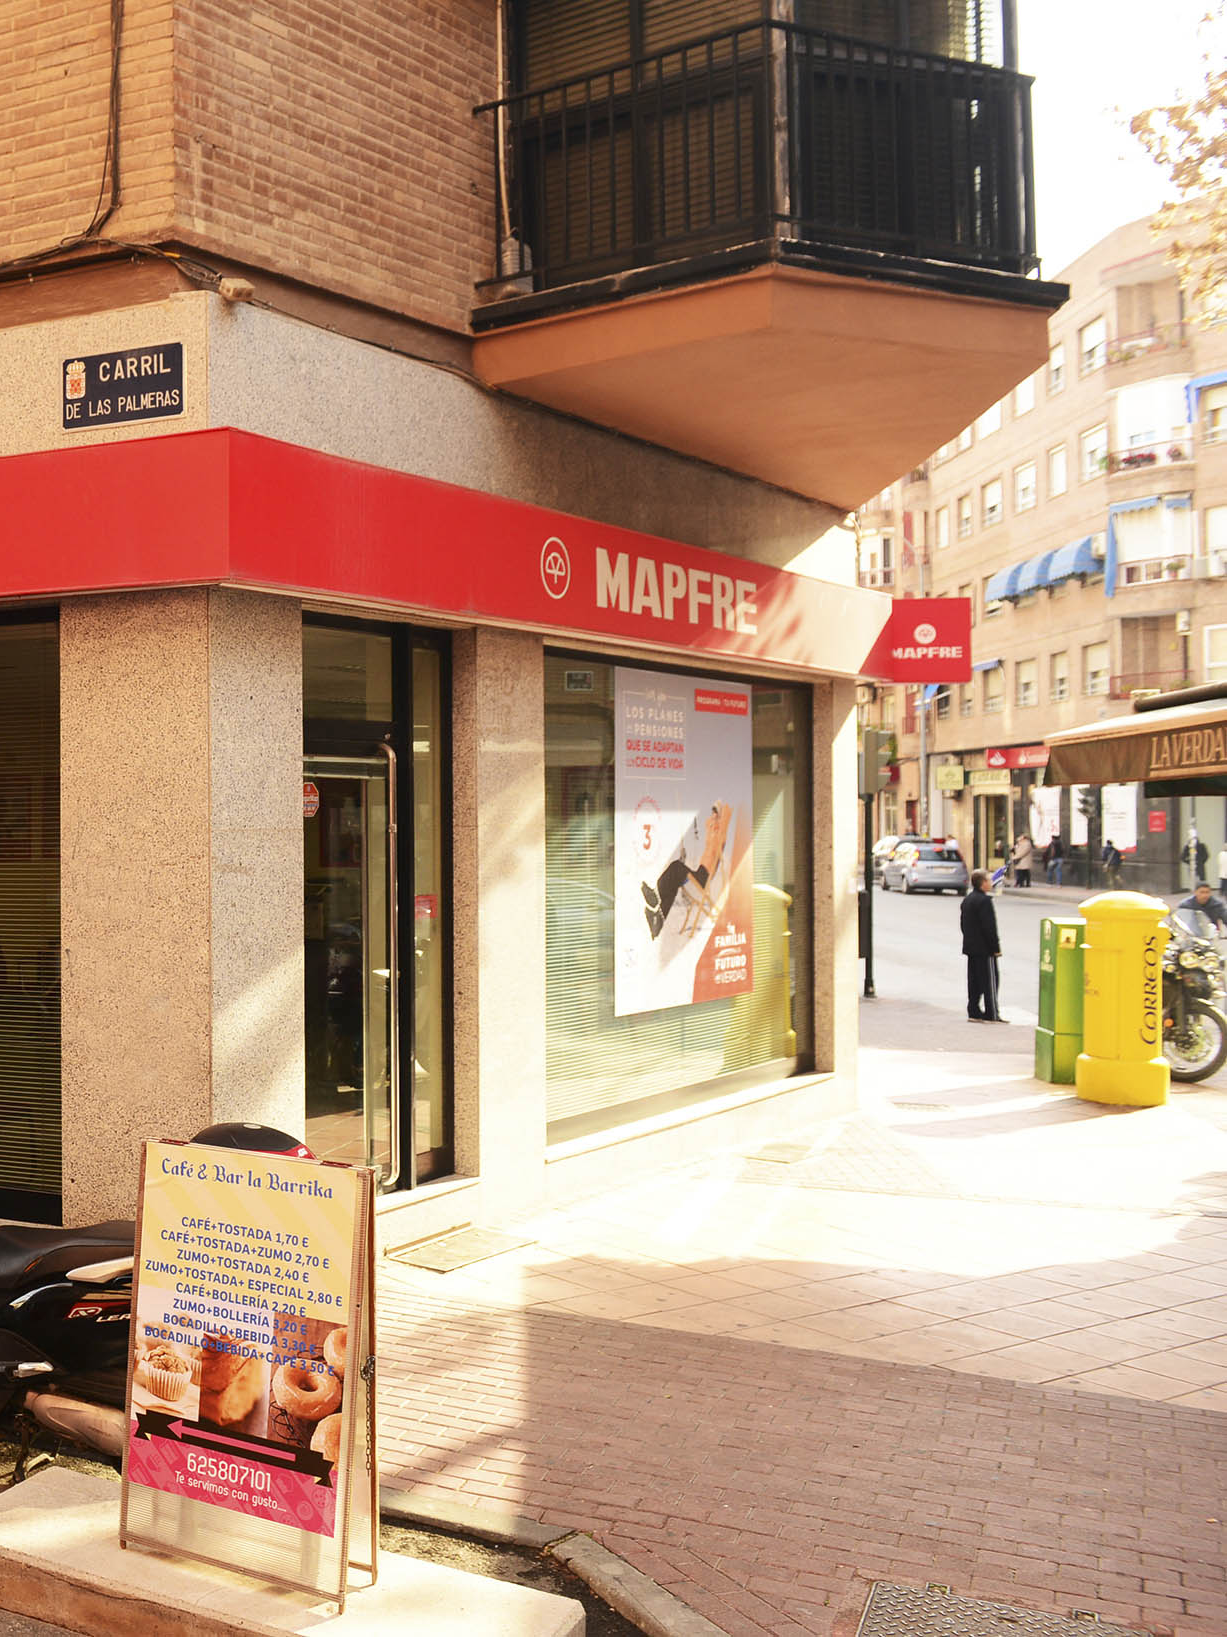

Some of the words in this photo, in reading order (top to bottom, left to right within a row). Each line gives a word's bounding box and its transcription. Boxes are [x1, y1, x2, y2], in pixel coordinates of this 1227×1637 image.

[99, 353, 171, 381] CARRIL
[66, 403, 81, 420] DE
[89, 399, 111, 417] LAS
[118, 389, 180, 413] PALMERAS
[595, 546, 758, 635] MAPFRE
[892, 646, 963, 659] MAPFRE
[626, 706, 644, 719] LOS
[648, 708, 684, 723] PLANES
[626, 739, 641, 751] QUE
[643, 740, 651, 752] SE
[653, 741, 684, 753] ADAPTAN
[634, 723, 684, 739] PENSIONES
[657, 757, 667, 769] DE
[715, 932, 747, 947] FAMILIA
[715, 954, 747, 970] FUTURO
[161, 1158, 194, 1178] Café
[197, 1164, 208, 1180] &
[213, 1164, 244, 1185] Bar
[248, 1171, 262, 1188] la
[266, 1172, 333, 1199] Barrika
[181, 1216, 272, 1242] CAFÉ+TOSTADA
[275, 1233, 299, 1247] 1,70
[302, 1237, 309, 1248] €
[160, 1229, 292, 1262] CAFÉ+TOSTADA+ZUMO
[295, 1253, 320, 1267] 2,70
[322, 1258, 330, 1269] €
[176, 1249, 271, 1276] ZUMO+TOSTADA
[274, 1267, 299, 1281] 2,40
[302, 1272, 309, 1283] €
[145, 1260, 245, 1288] ZUMO+TOSTADA+
[248, 1279, 304, 1300] ESPECIAL
[306, 1290, 332, 1305] 2,80
[335, 1296, 343, 1307] €
[176, 1282, 269, 1310] CAFÉ+BOLLERÍA
[299, 1306, 306, 1318] €
[173, 1298, 270, 1328] ZUMO+BOLLERÍA
[273, 1319, 297, 1334] 3,20
[300, 1324, 307, 1335] €
[163, 1313, 278, 1347] BOCADILLO+BEBIDA
[281, 1338, 306, 1353] 3,30
[309, 1344, 317, 1355] €
[144, 1326, 297, 1368] BOCADILLO+BEBIDA+CAFÉ
[300, 1360, 324, 1374] 3,50
[327, 1365, 335, 1377] €
[175, 1470, 185, 1484] Te
[188, 1477, 229, 1496] servimos
[231, 1489, 249, 1502] con
[187, 1453, 271, 1492] 625807101
